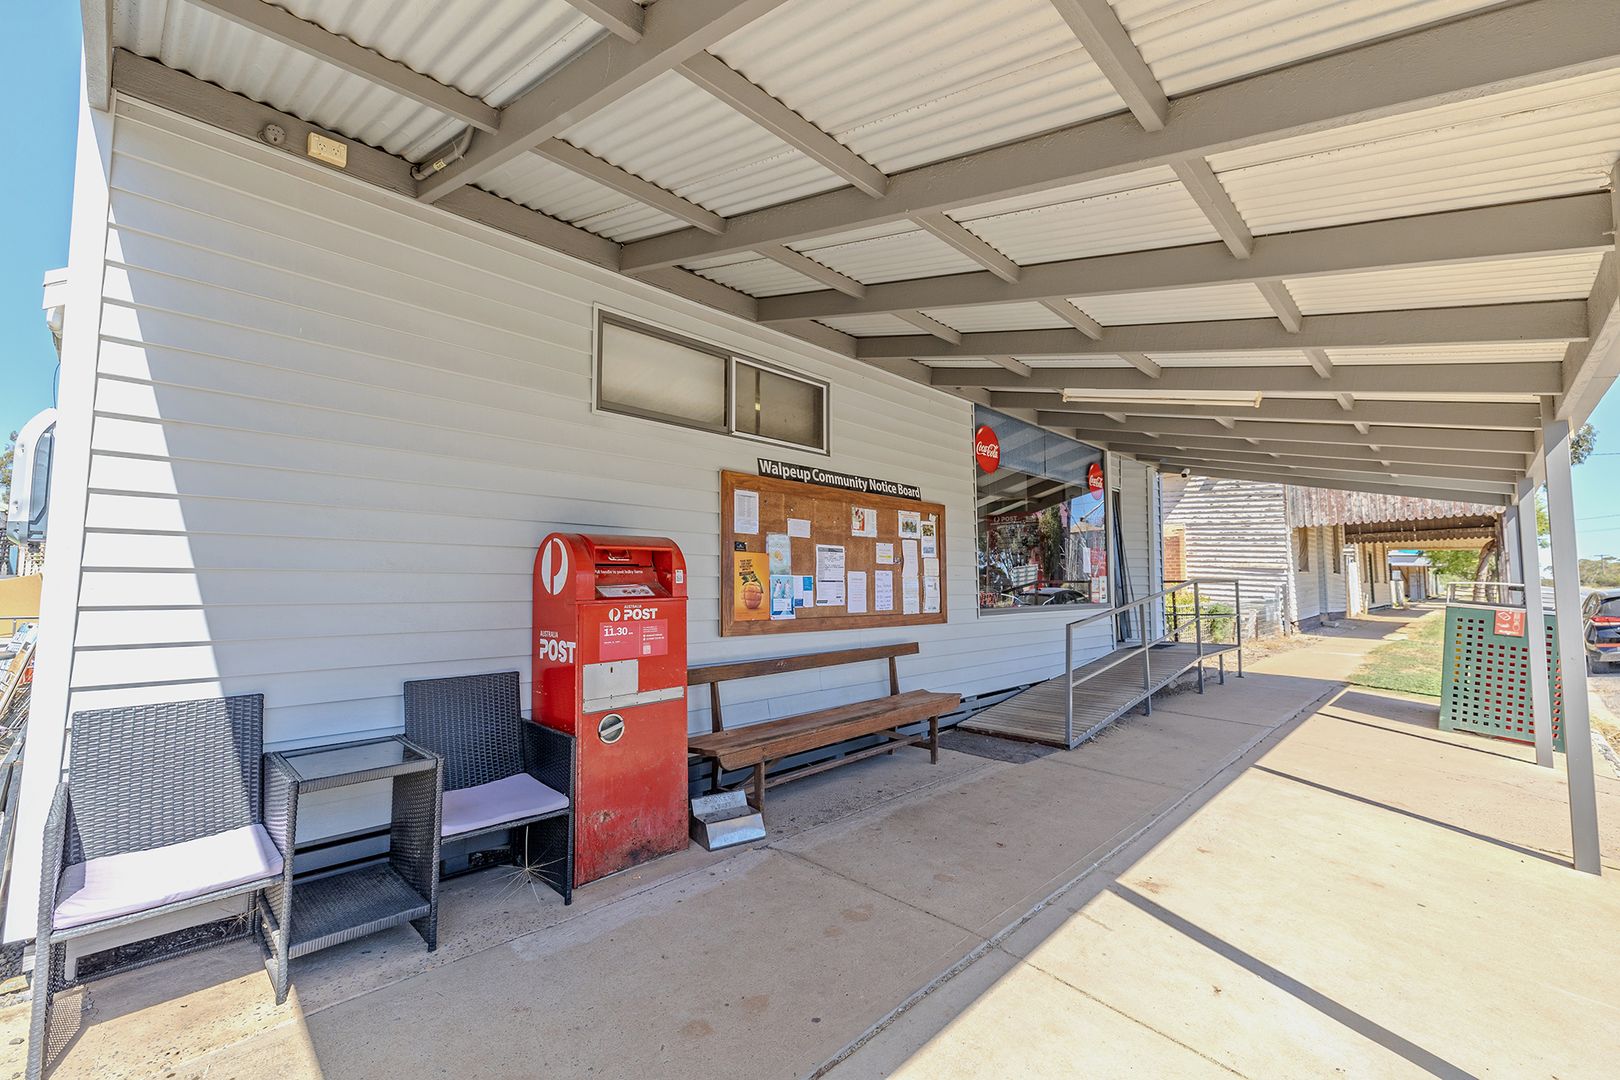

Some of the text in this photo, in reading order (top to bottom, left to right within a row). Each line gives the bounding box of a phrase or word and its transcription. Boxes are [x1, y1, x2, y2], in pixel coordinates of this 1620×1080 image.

[976, 441, 998, 459] Coca-Cola
[758, 459, 920, 498] Walpeup Community Notice Board
[623, 608, 658, 621] POST
[604, 627, 628, 637] 11.30
[539, 638, 577, 664] POST
